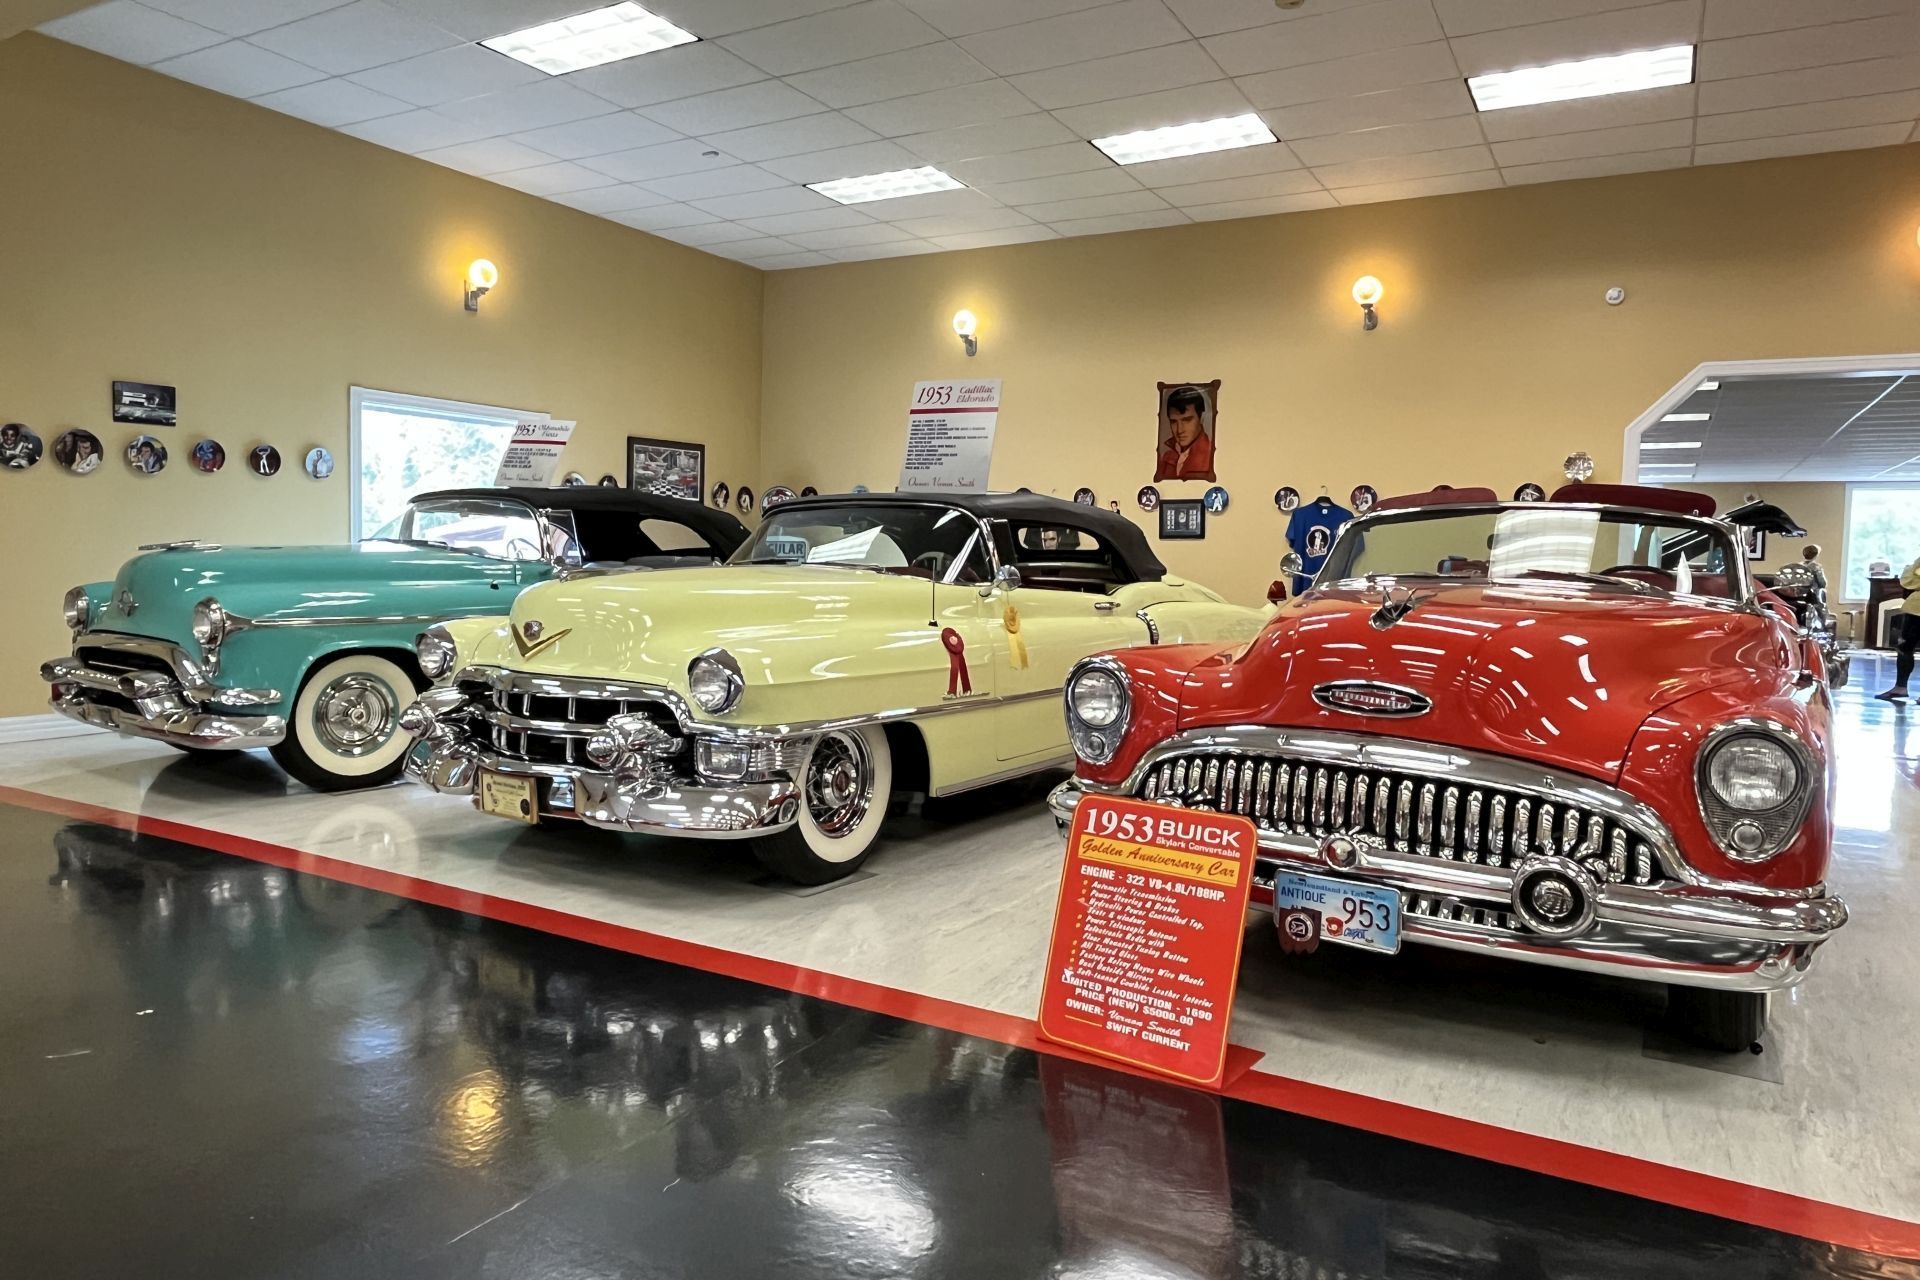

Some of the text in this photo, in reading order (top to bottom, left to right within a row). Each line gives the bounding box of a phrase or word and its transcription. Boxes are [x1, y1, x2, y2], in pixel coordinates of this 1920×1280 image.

[917, 386, 953, 405] 1953
[956, 394, 995, 404] Eldorado
[960, 385, 995, 395] Cadillac
[1084, 809, 1241, 847] 1953 BUICK
[1082, 839, 1234, 877] Golden Anniversary Car
[1081, 865, 1115, 880] ENGINE
[1126, 874, 1145, 886] 322
[1090, 889, 1111, 899] Power
[1113, 894, 1143, 908] Steering
[1154, 903, 1179, 914] Brakes
[1091, 881, 1176, 904] Automatic Transmission
[1281, 886, 1326, 904] ANTIQUE
[1086, 915, 1107, 925] Power
[1109, 920, 1144, 934] Telescopic
[1124, 906, 1146, 916] Power
[1148, 911, 1188, 925] Controlled
[1342, 896, 1391, 932] 953
[1081, 941, 1138, 960] All Tinted Glass
[1102, 937, 1134, 951] Mounted
[1135, 944, 1160, 958] Tuning
[1163, 951, 1188, 963] Button
[1125, 933, 1146, 944] Radio
[1148, 939, 1164, 947] with
[1079, 950, 1106, 965] Factory
[1133, 963, 1154, 974] Hayes
[1158, 969, 1175, 979] Wire
[1178, 973, 1204, 986] Wheels
[1079, 958, 1153, 983] Dual Outside Mirrors
[1104, 986, 1172, 1010] PRODUCTION
[1120, 978, 1150, 991] Cowhide
[1152, 986, 1180, 999] Leather
[1183, 994, 1213, 1008] Interior
[1066, 998, 1181, 1037] OWNER: Vernon Smith
[1075, 988, 1195, 1026] PRICE (NEW) $5000.00
[1106, 1021, 1191, 1051] SWIFT CURRENT
